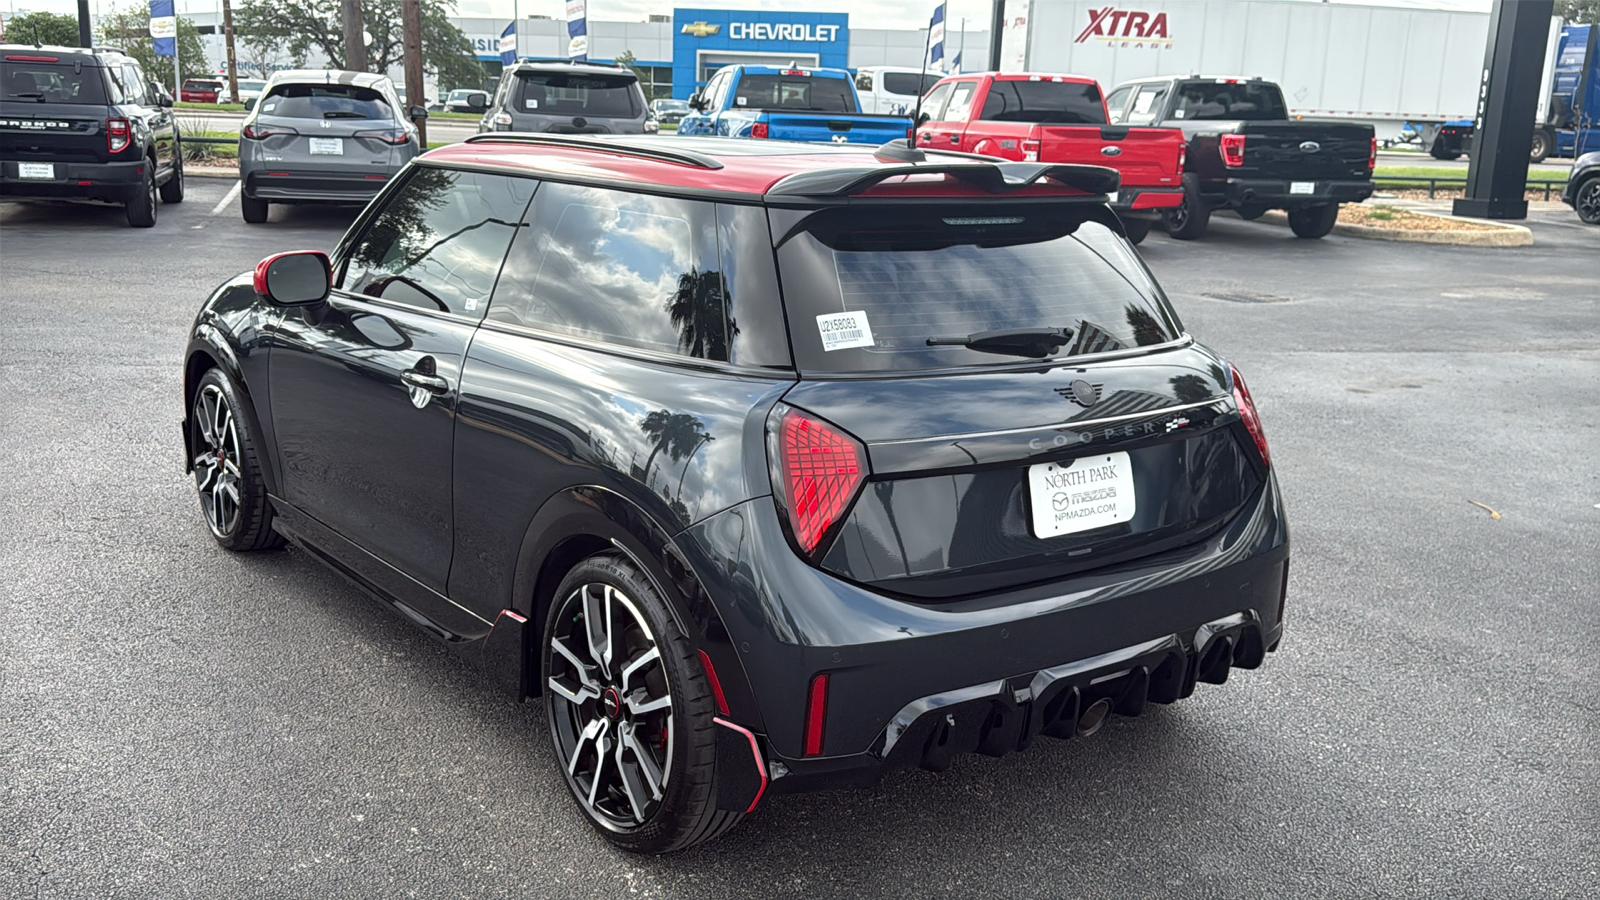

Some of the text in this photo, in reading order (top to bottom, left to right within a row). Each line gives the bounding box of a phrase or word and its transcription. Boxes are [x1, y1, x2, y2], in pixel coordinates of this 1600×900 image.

[729, 22, 840, 42] CHEVROLET
[1074, 7, 1168, 43] XTRA
[1107, 41, 1173, 49] LEASE
[820, 317, 857, 332] U2X58083
[1029, 422, 1154, 450] COOPER
[1045, 465, 1118, 490] NORTH PARK
[1054, 503, 1117, 522] NPMAZDA.COM
